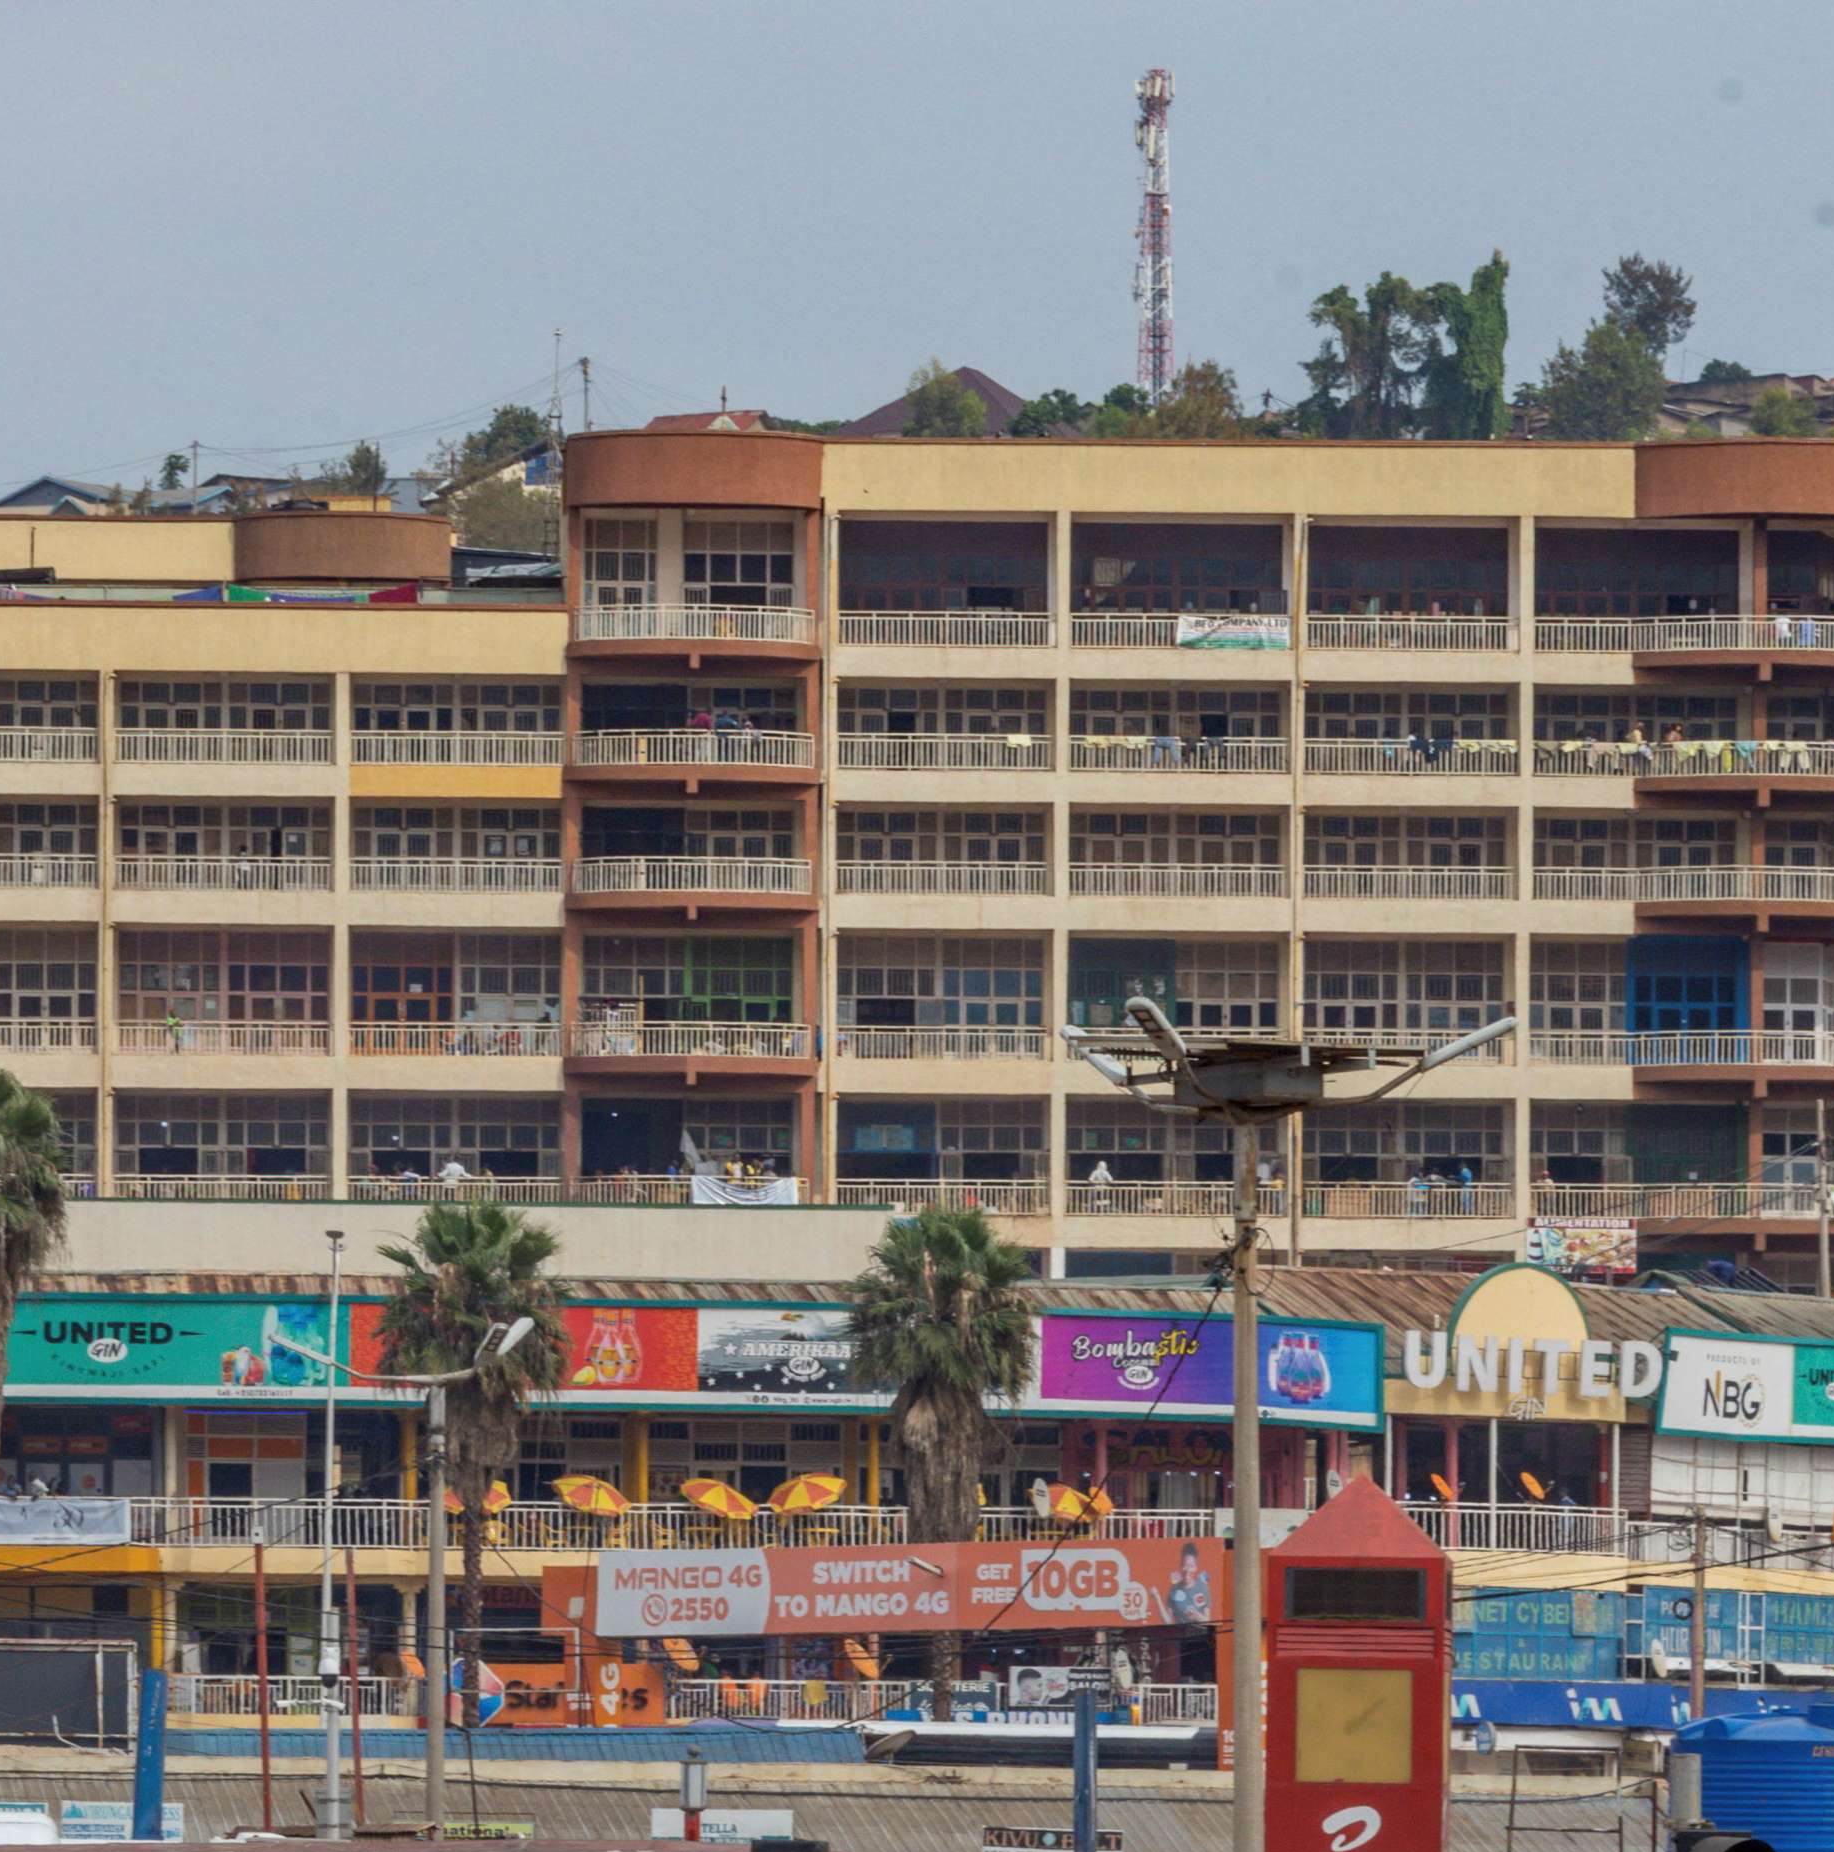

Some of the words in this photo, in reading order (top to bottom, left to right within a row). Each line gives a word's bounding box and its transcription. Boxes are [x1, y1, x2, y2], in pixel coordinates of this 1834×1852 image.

[1534, 1218, 1630, 1229] ALIMENTATION
[44, 1321, 173, 1345] UNITED
[90, 1340, 125, 1358] GIN
[741, 1341, 852, 1358] AMERIKAA
[1071, 1329, 1199, 1366] Bombastic
[1404, 1330, 1664, 1399] UNITED
[1702, 1370, 1761, 1420] NBG
[1507, 1397, 1549, 1420] GIN
[615, 1567, 722, 1590] MANGO
[729, 1565, 762, 1588] 4G
[813, 1561, 910, 1585] SWITCH
[976, 1563, 1011, 1581] GET
[1028, 1560, 1120, 1599] 10GB
[774, 1595, 807, 1617] TO
[815, 1593, 907, 1617] MANGO
[914, 1591, 949, 1615] 4G
[971, 1586, 1017, 1604] FREE
[1122, 1591, 1144, 1608] 30
[670, 1597, 729, 1621] 2550
[1518, 1600, 1570, 1625] CYBE
[702, 1823, 739, 1834] TELLA
[985, 1829, 1039, 1847] KIVU
[1061, 1832, 1120, 1851] BT
